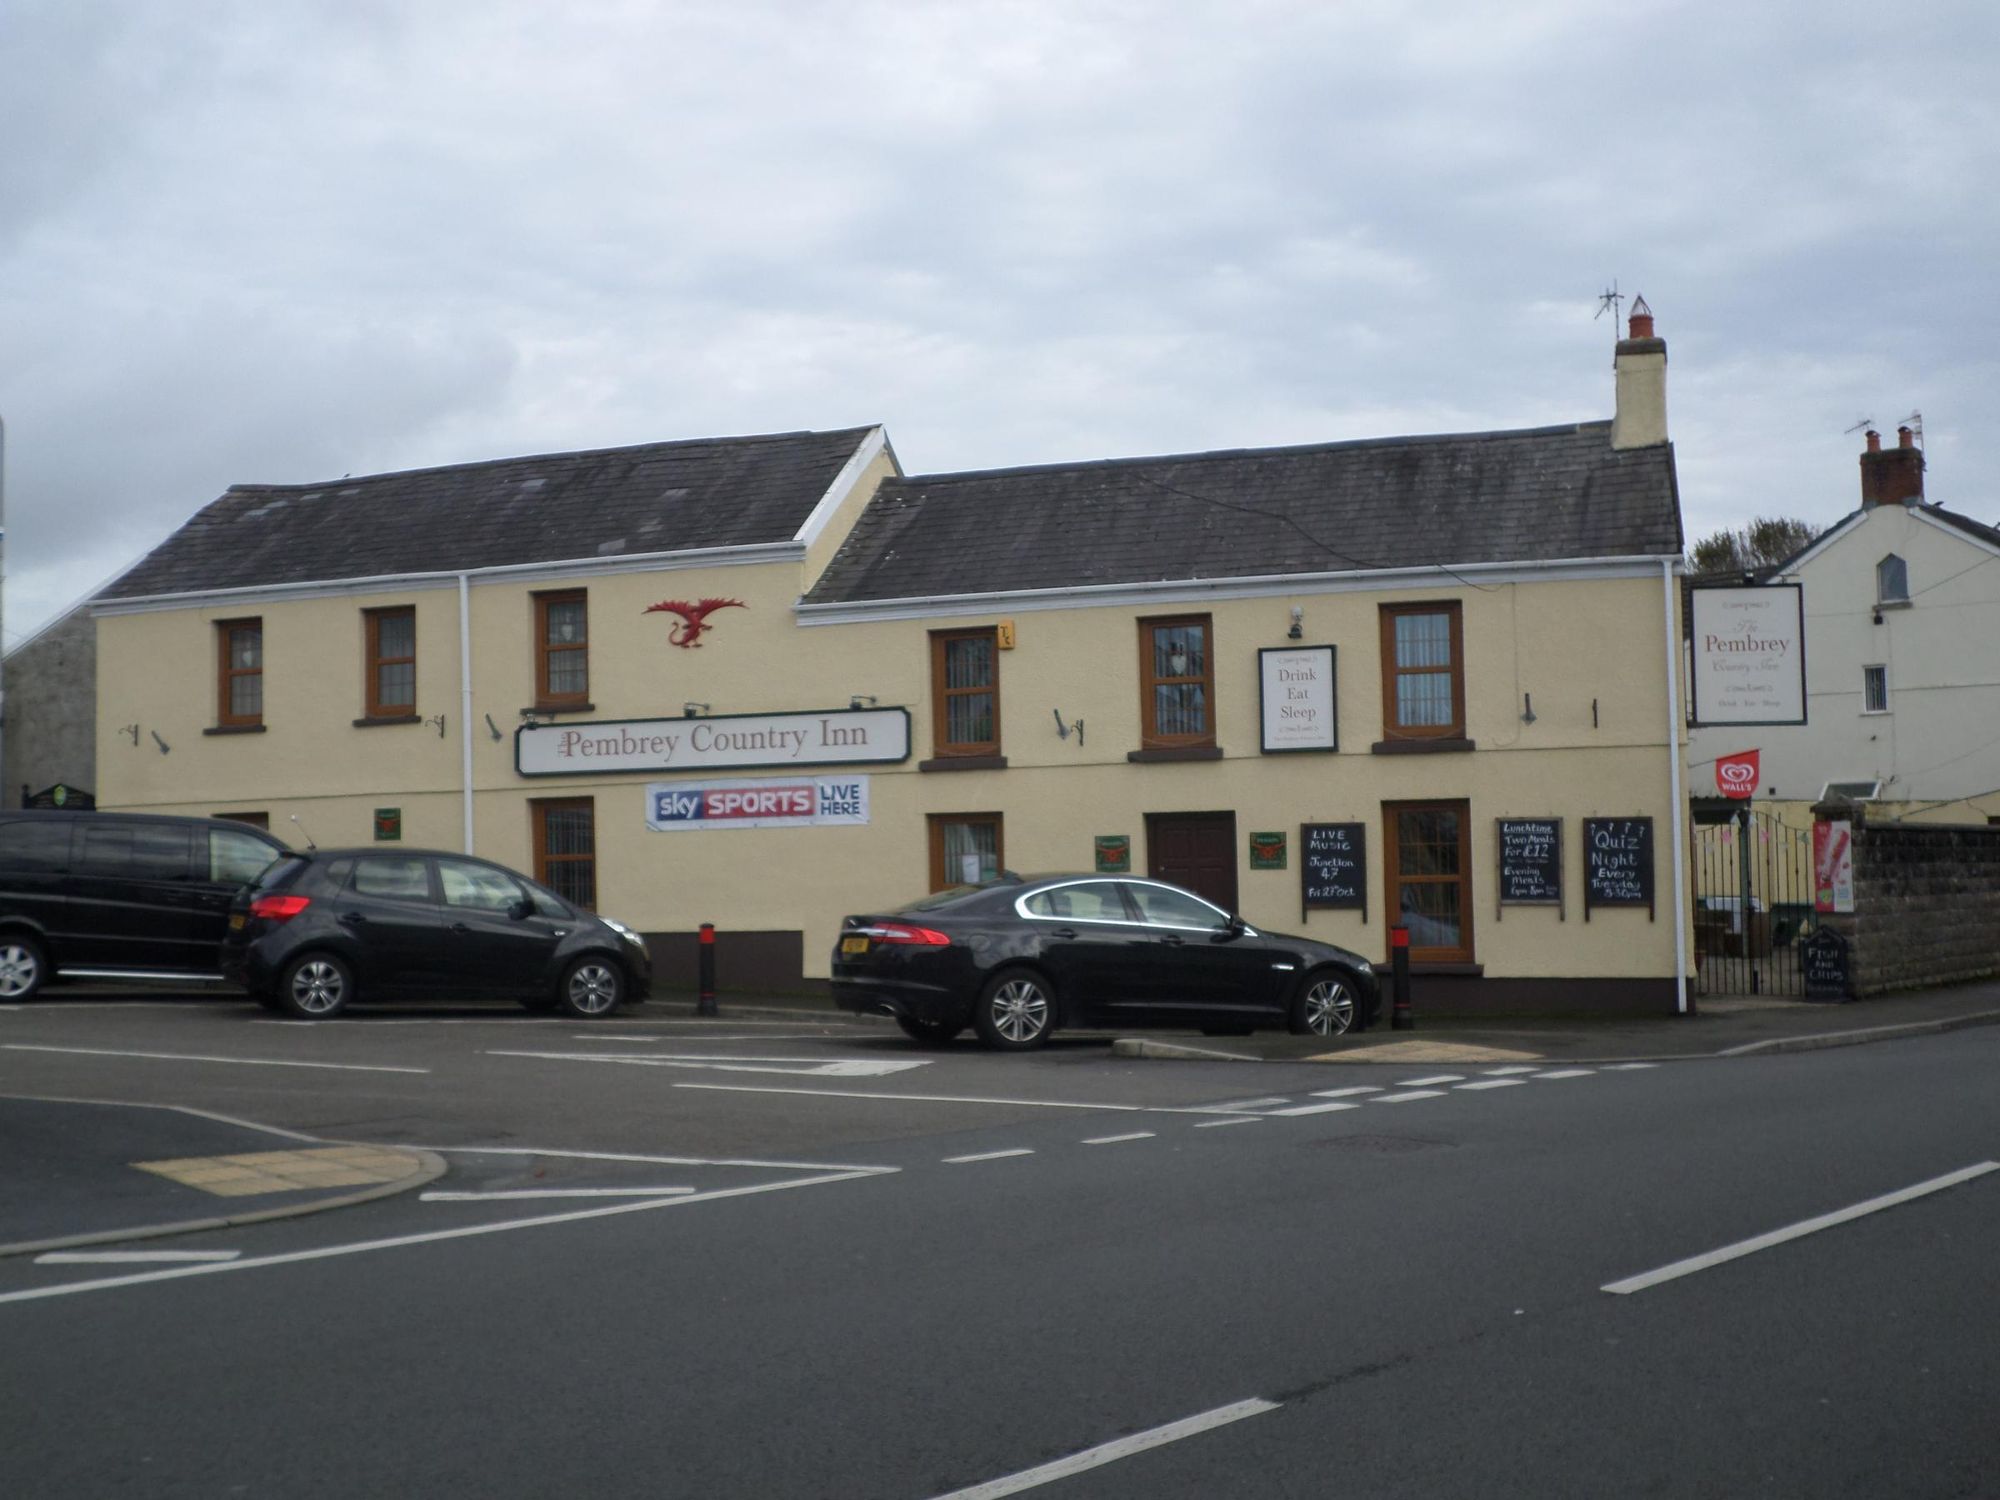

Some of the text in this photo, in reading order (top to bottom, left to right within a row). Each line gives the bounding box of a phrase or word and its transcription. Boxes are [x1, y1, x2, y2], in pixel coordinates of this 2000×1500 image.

[1705, 634, 1790, 657] Pembrey
[1279, 667, 1317, 681] Drink
[1287, 688, 1309, 700] Eat
[1280, 705, 1317, 721] Sleep
[564, 728, 680, 762] Pembrey
[690, 724, 808, 757] Country
[818, 719, 868, 746] Inn
[820, 784, 860, 800] LIVE
[660, 790, 809, 819] sky SPORTS
[820, 801, 860, 815] HERE
[1313, 830, 1346, 840] LIVE
[1595, 830, 1640, 850] Quiz
[1310, 840, 1351, 851] MUSIC
[1523, 844, 1549, 857] £12
[1592, 852, 1637, 870] Night
[1598, 867, 1635, 879] Every
